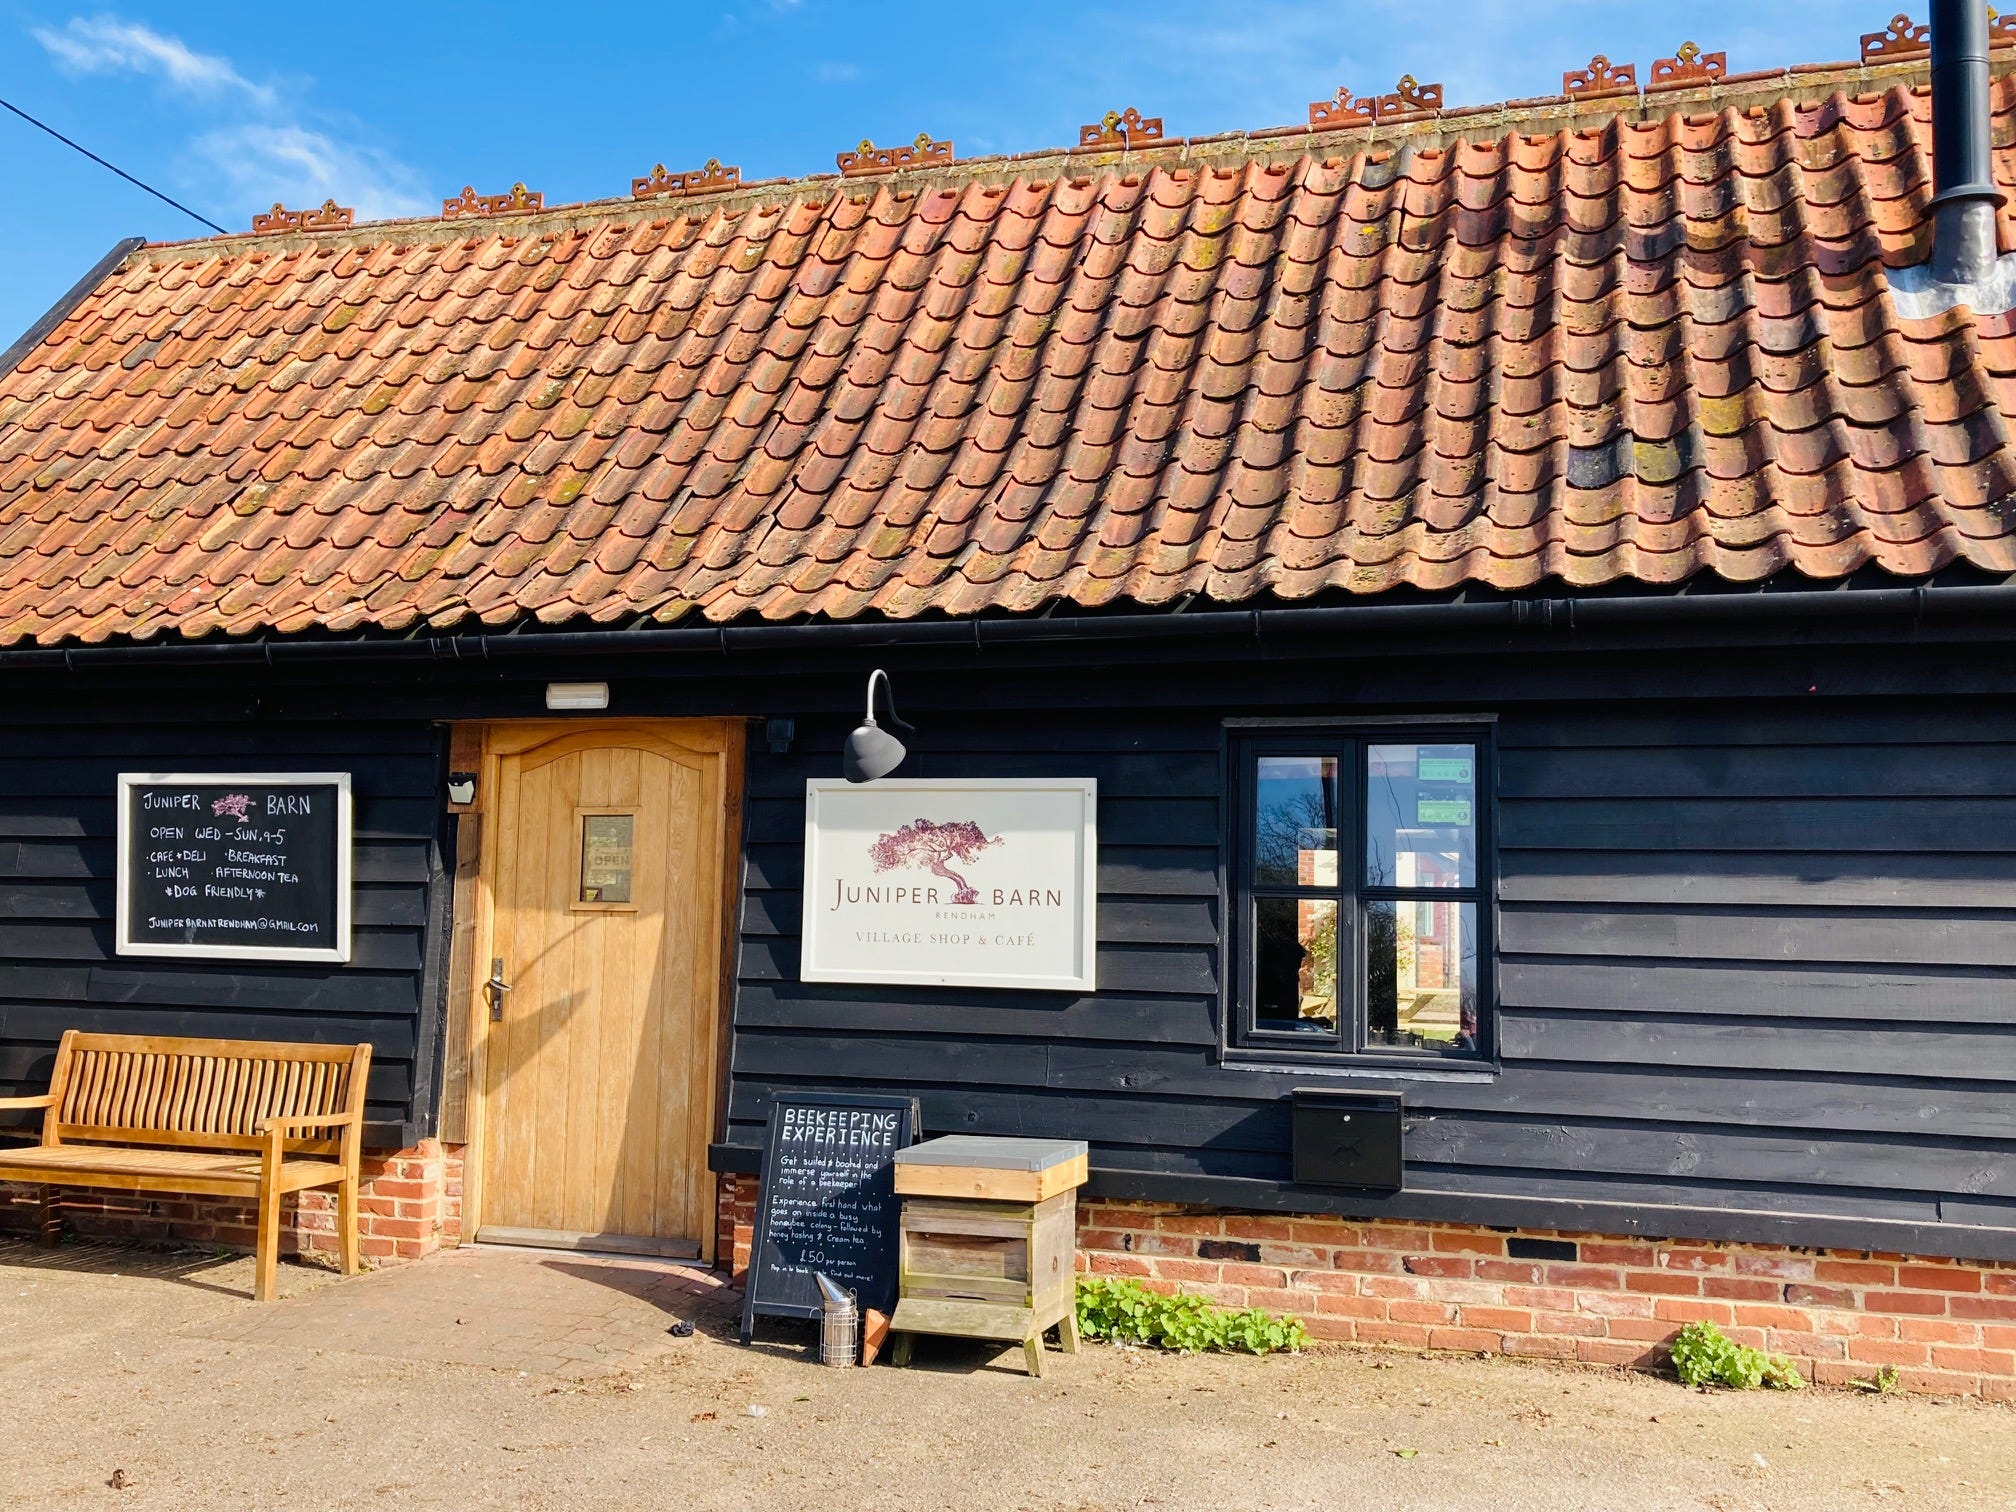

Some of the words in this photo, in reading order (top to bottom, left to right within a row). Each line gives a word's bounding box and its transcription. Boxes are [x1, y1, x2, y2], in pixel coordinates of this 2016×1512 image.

[143, 792, 201, 811] JUNIPER
[267, 794, 311, 816] BARN
[150, 826, 184, 840] OPEN
[150, 851, 174, 863] CAFE
[228, 849, 287, 867] BREAKFAST
[594, 855, 630, 866] OPEN
[155, 867, 189, 879] LUNCH
[215, 866, 276, 881] AFTERNOON
[277, 872, 299, 884] TEA
[830, 878, 939, 911] JUNIPER
[992, 889, 1062, 907] BARN
[935, 911, 997, 921] RENDHAM
[855, 931, 922, 944] VILLAGE
[929, 933, 971, 945] SHOP
[978, 936, 987, 946] &
[995, 932, 1036, 947] CAFÉ
[785, 1108, 898, 1131] BEEKEEPING
[781, 1125, 892, 1147] EXPERIENCE
[780, 1155, 798, 1166] Get
[803, 1156, 827, 1167] suited
[835, 1156, 862, 1169] booted
[864, 1160, 879, 1169] and
[780, 1167, 816, 1176] immerse
[820, 1168, 850, 1180] yourself
[860, 1170, 872, 1180] the
[779, 1176, 795, 1185] role
[798, 1176, 808, 1186] of
[818, 1177, 862, 1190] beekeeper!
[772, 1195, 818, 1208] Experience
[861, 1201, 882, 1212] what
[770, 1208, 788, 1217] goes
[805, 1208, 828, 1218] inside
[839, 1211, 859, 1223] busy
[769, 1216, 806, 1230] honeybee
[871, 1225, 882, 1238] by
[768, 1228, 789, 1242] honey
[826, 1233, 850, 1244] Cream
[799, 1249, 825, 1263] £50
